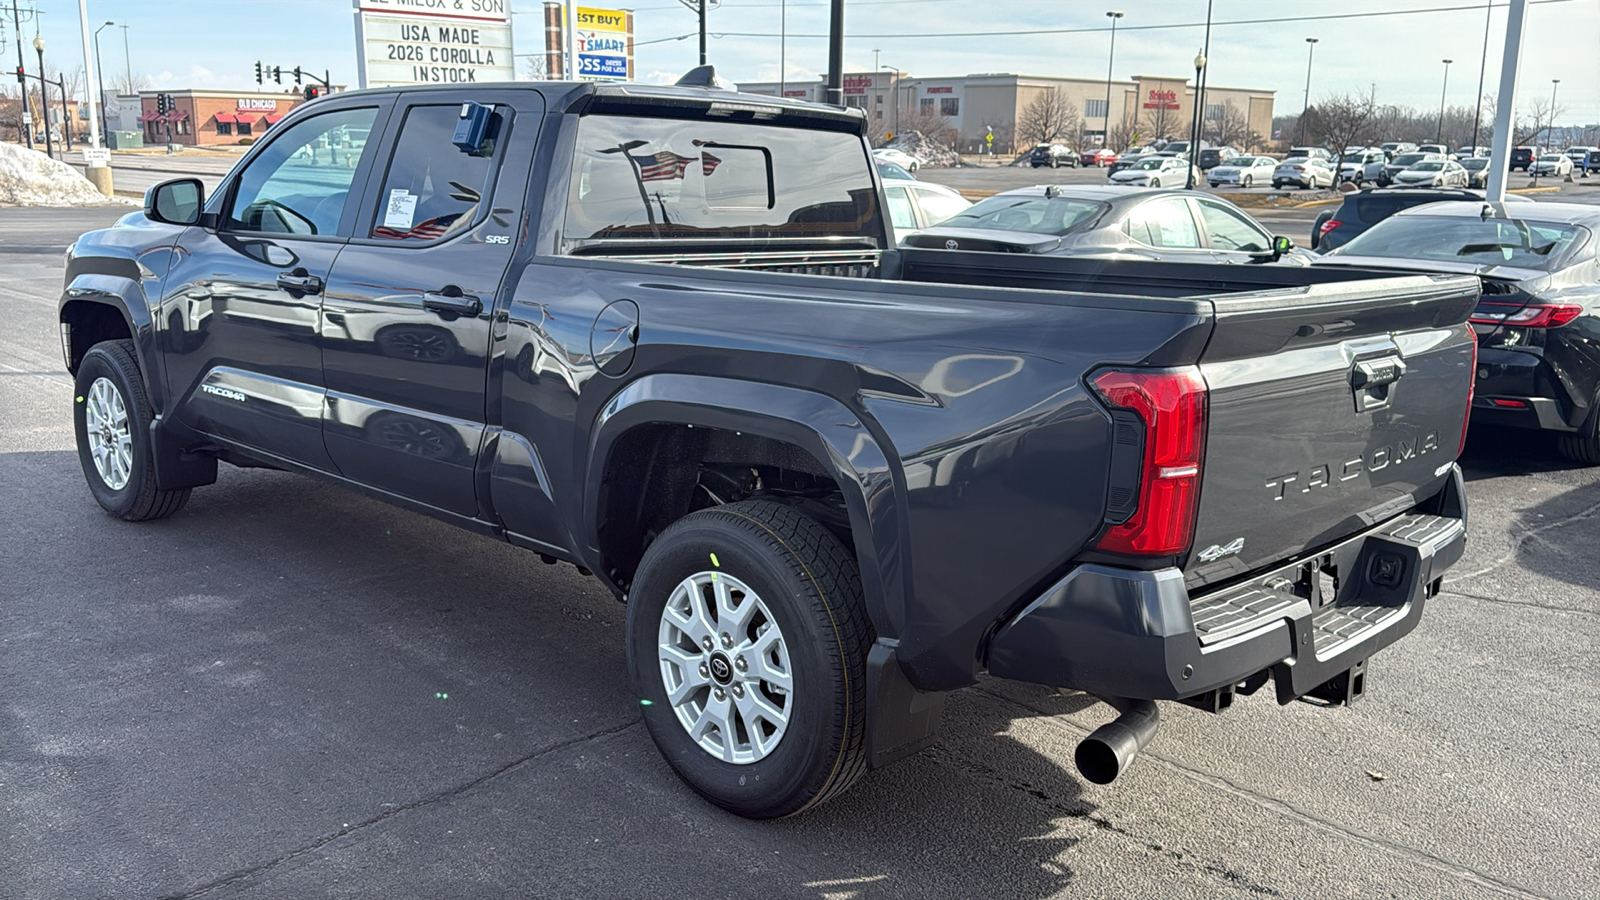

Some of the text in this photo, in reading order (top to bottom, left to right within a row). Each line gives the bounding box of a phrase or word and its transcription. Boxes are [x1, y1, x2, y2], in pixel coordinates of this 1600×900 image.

[453, 0, 463, 10] &
[471, 0, 503, 13] SON
[577, 12, 622, 26] EST BUY
[401, 24, 479, 45] USA MADE
[387, 44, 495, 66] 2026 COROLLA
[578, 57, 601, 72] OSS
[238, 99, 276, 109] OLD CHICAGO
[485, 234, 510, 244] SR5
[201, 384, 245, 402] TACOMA
[1265, 430, 1439, 501] TACOMA
